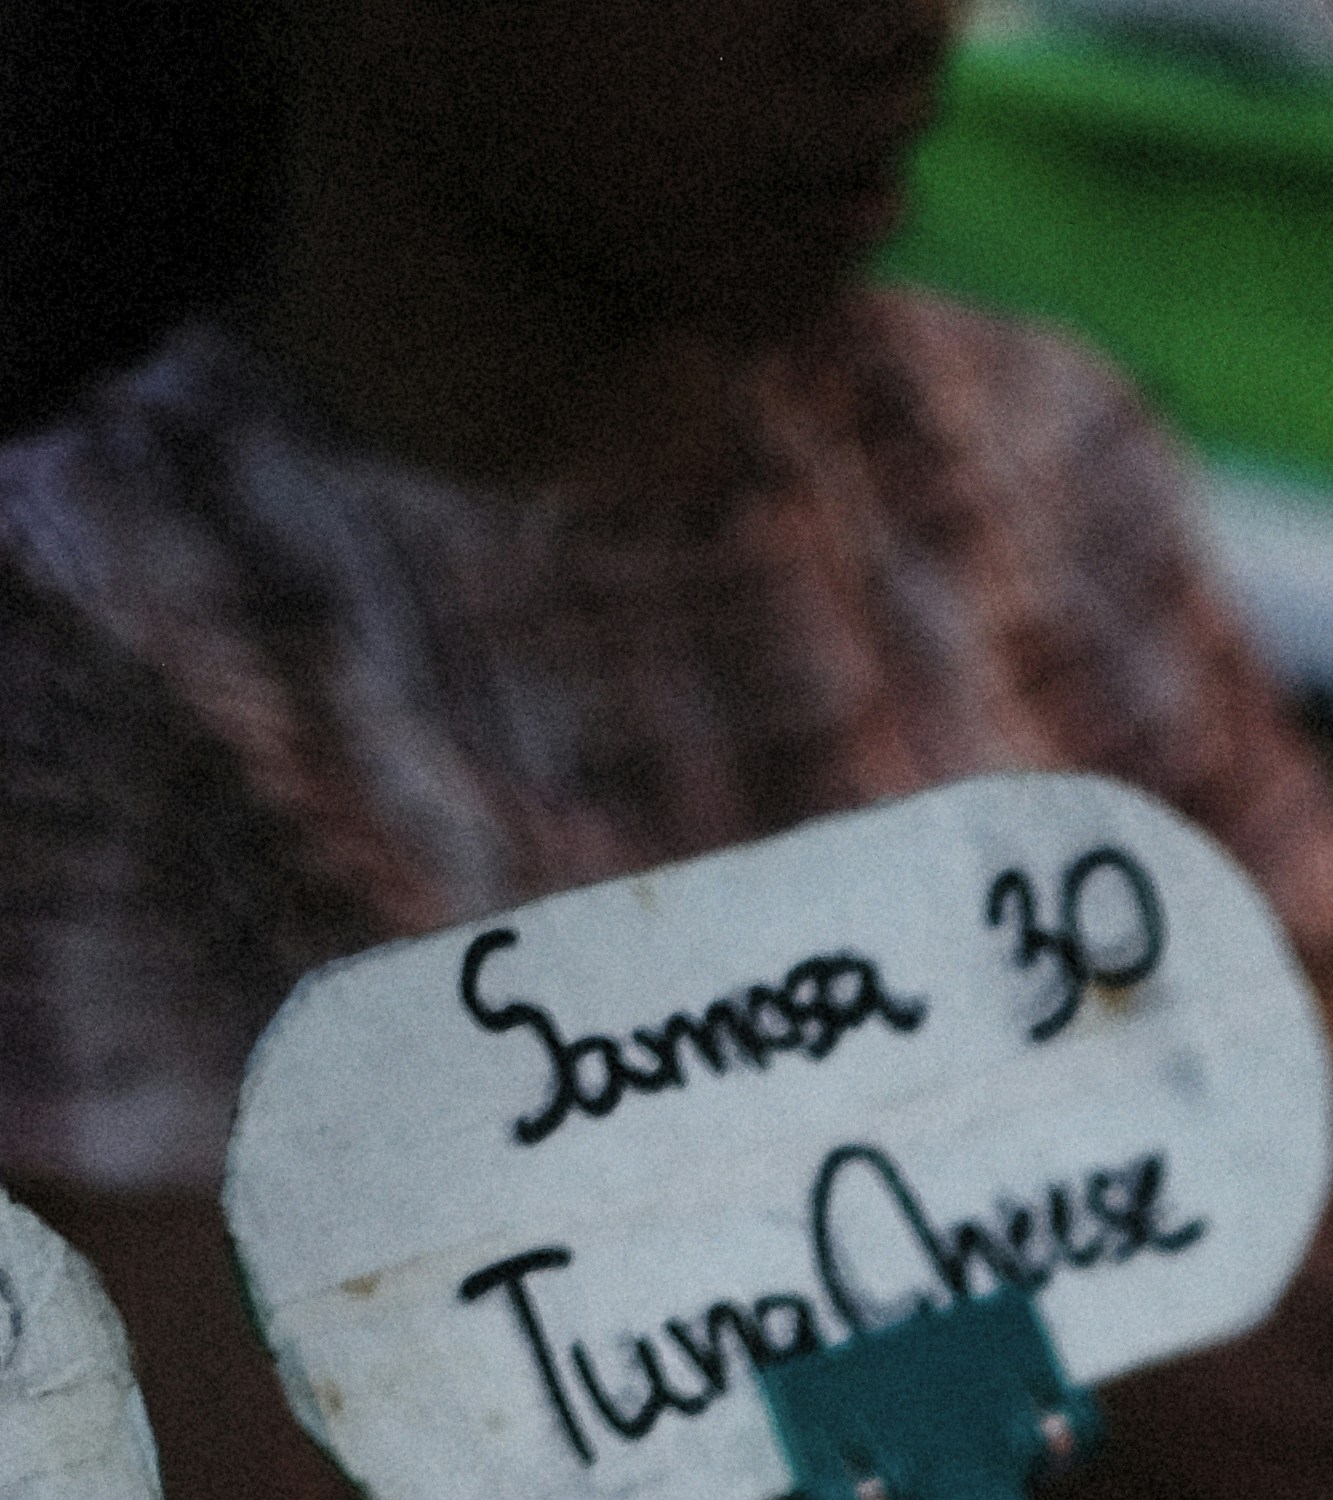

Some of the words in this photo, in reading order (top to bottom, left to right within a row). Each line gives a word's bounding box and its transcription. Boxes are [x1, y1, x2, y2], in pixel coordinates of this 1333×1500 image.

[459, 927, 925, 1143] Samosa
[984, 845, 1168, 1041] 30
[459, 1247, 818, 1466] Tuna
